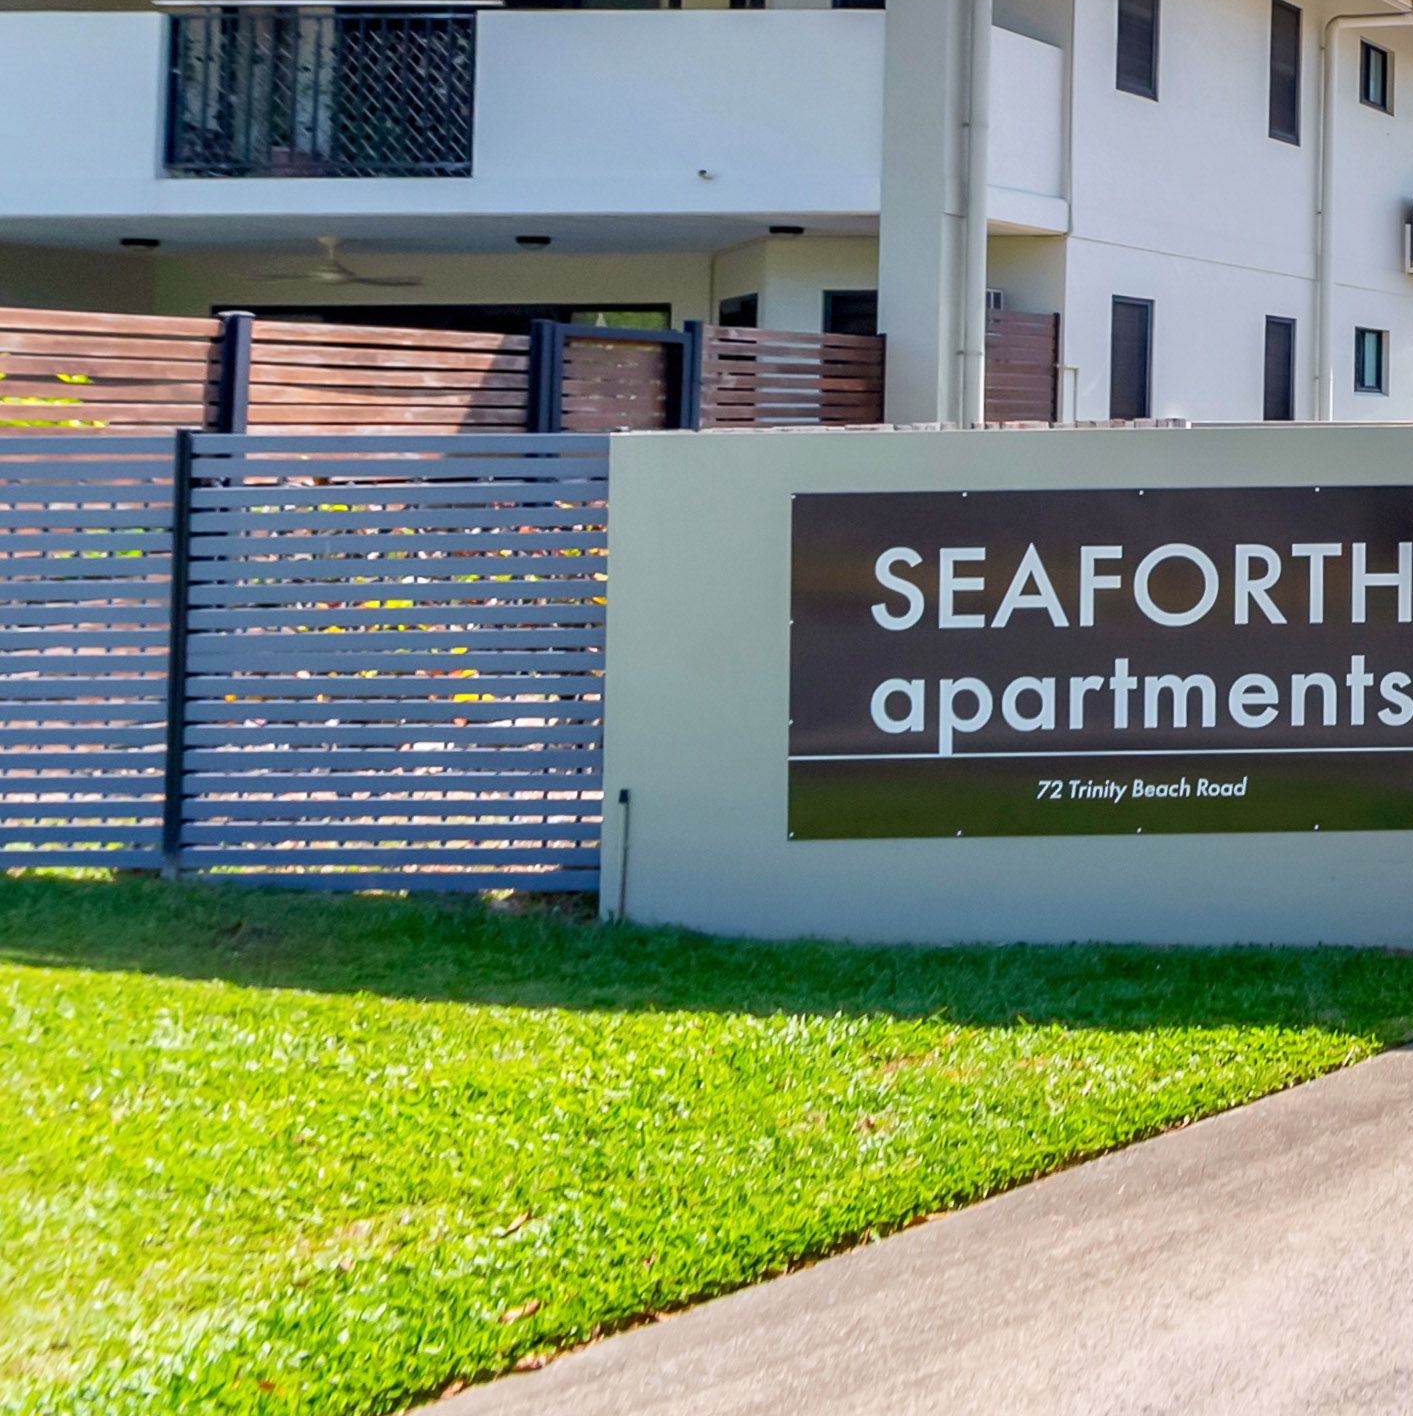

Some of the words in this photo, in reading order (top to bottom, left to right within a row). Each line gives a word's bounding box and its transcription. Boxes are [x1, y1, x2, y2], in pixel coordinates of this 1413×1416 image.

[870, 541, 1413, 631] SEAFORTH
[1035, 779, 1063, 800] 72
[1068, 778, 1128, 804] Trinity
[1131, 776, 1190, 800] Beach
[1196, 775, 1248, 798] Road
